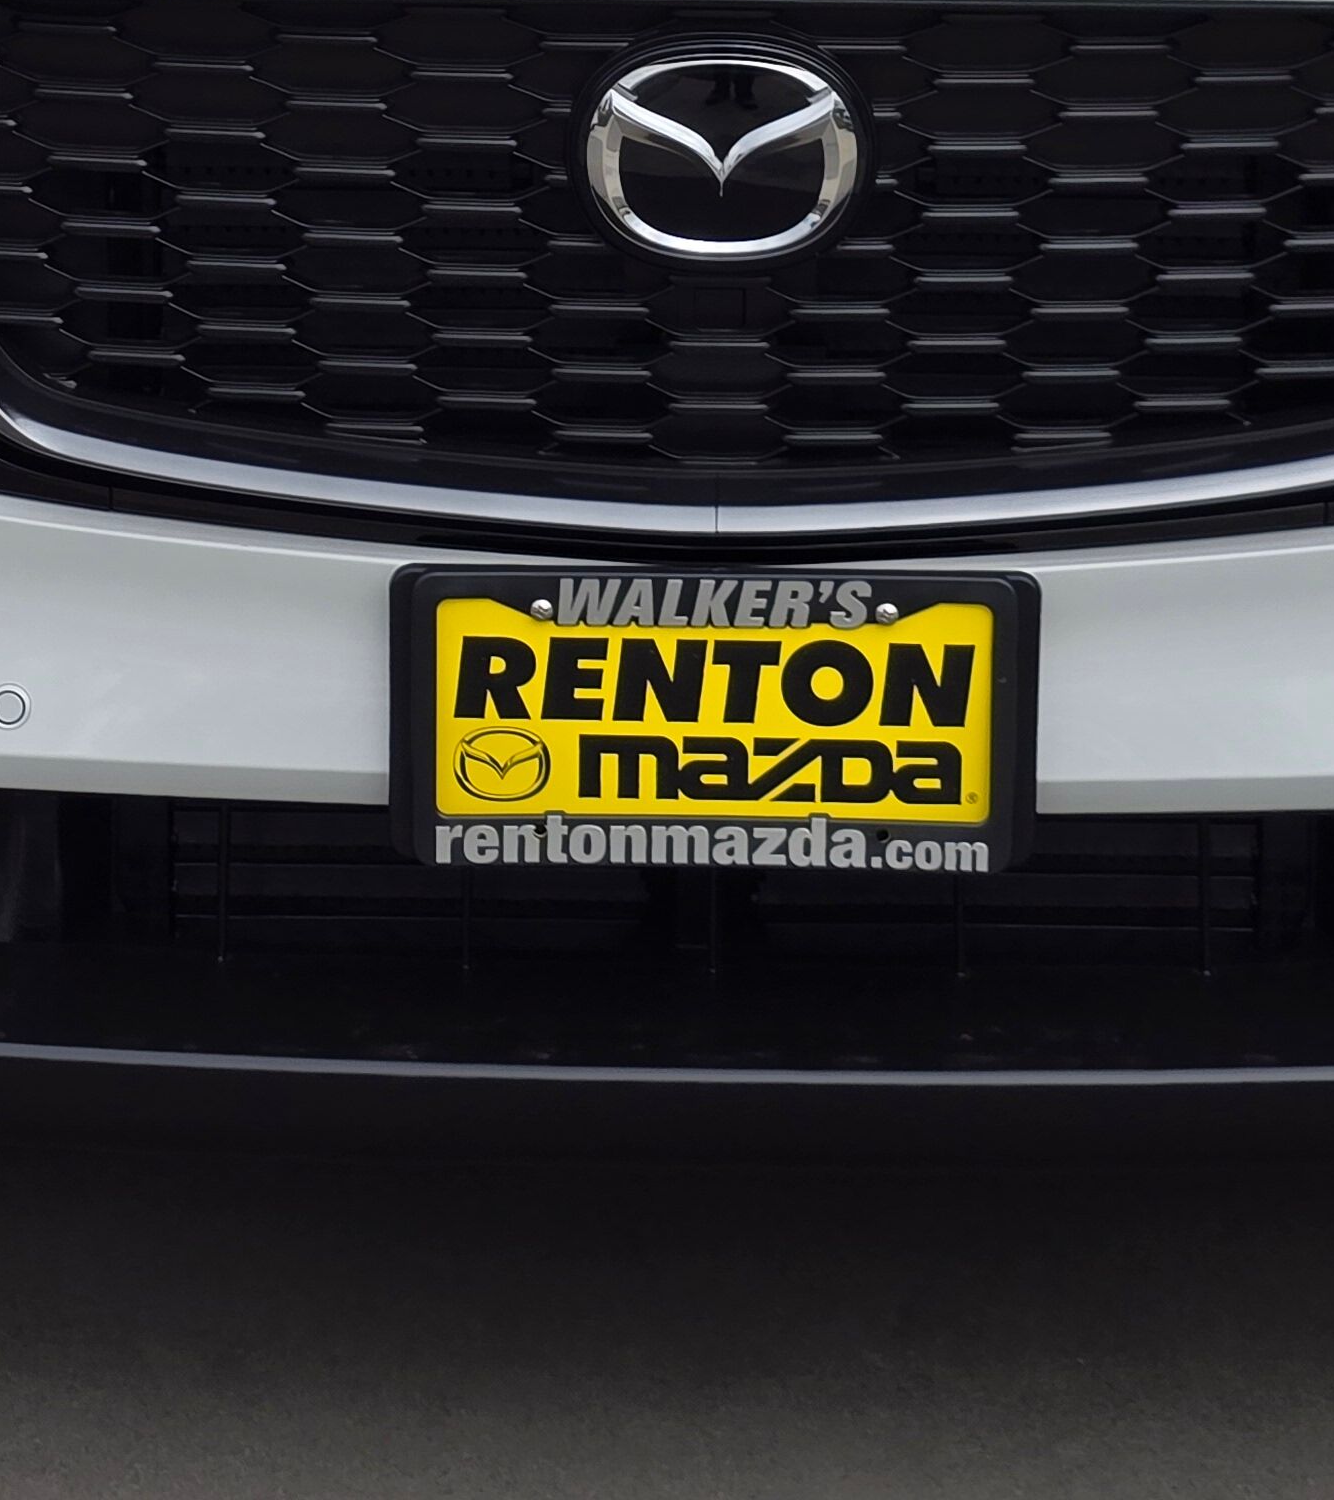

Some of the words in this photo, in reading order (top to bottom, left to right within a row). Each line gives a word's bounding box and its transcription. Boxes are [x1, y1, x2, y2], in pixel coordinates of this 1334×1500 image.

[555, 577, 872, 629] WALKER'S
[454, 635, 975, 728] RENTON
[578, 733, 962, 805] mazda
[435, 814, 990, 873] rentonmazda.com
